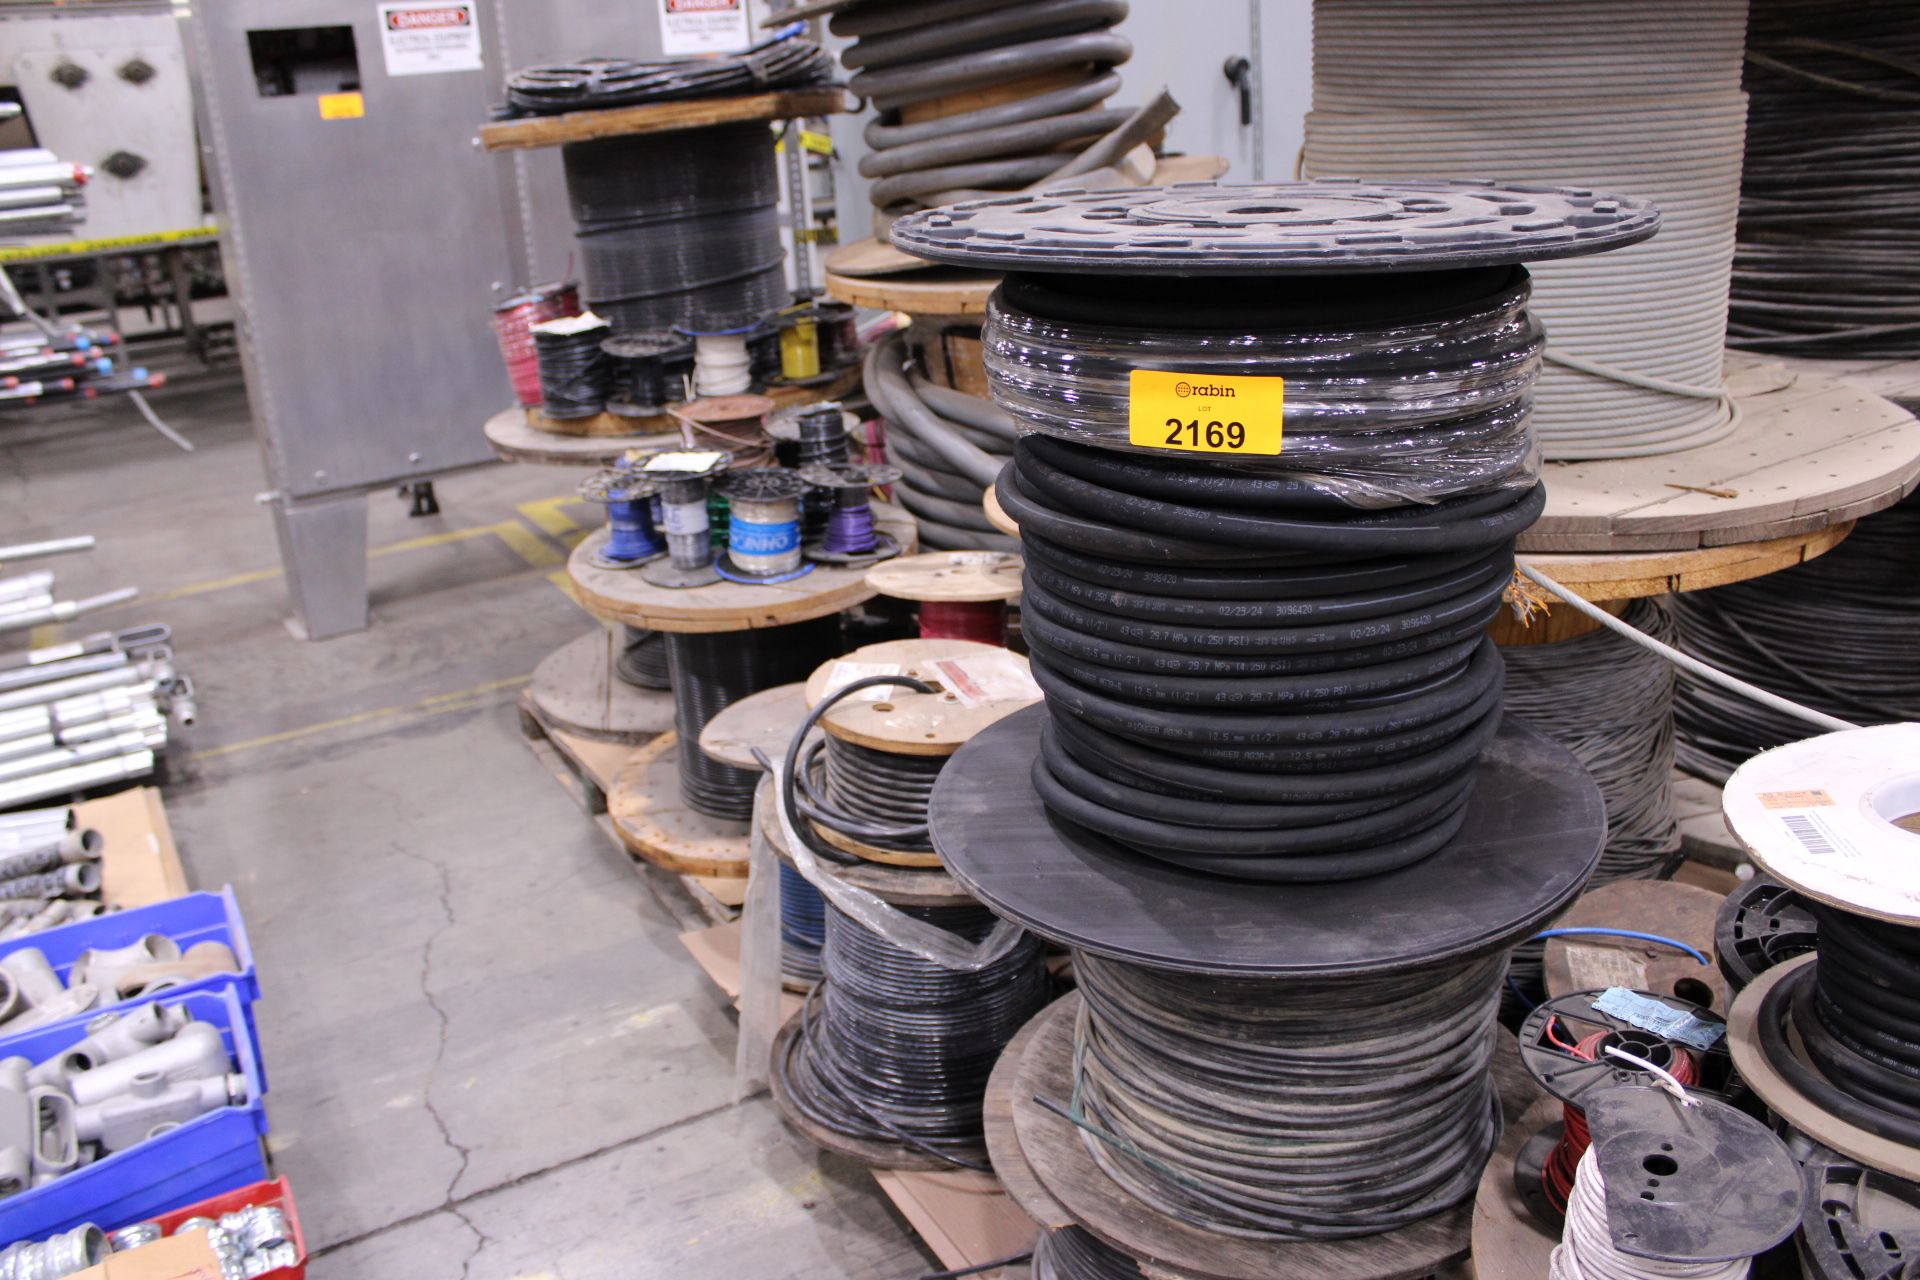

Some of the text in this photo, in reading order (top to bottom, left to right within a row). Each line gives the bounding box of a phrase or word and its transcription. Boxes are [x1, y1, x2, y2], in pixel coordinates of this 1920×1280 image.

[1165, 418, 1246, 448] 2169
[1218, 605, 1264, 617] 02/23/24
[1275, 604, 1313, 617] 3096420
[1350, 623, 1391, 639] 02/23/24
[1400, 616, 1432, 631] 3096420
[1189, 660, 1211, 672] 29.7
[1214, 660, 1231, 672] MPa
